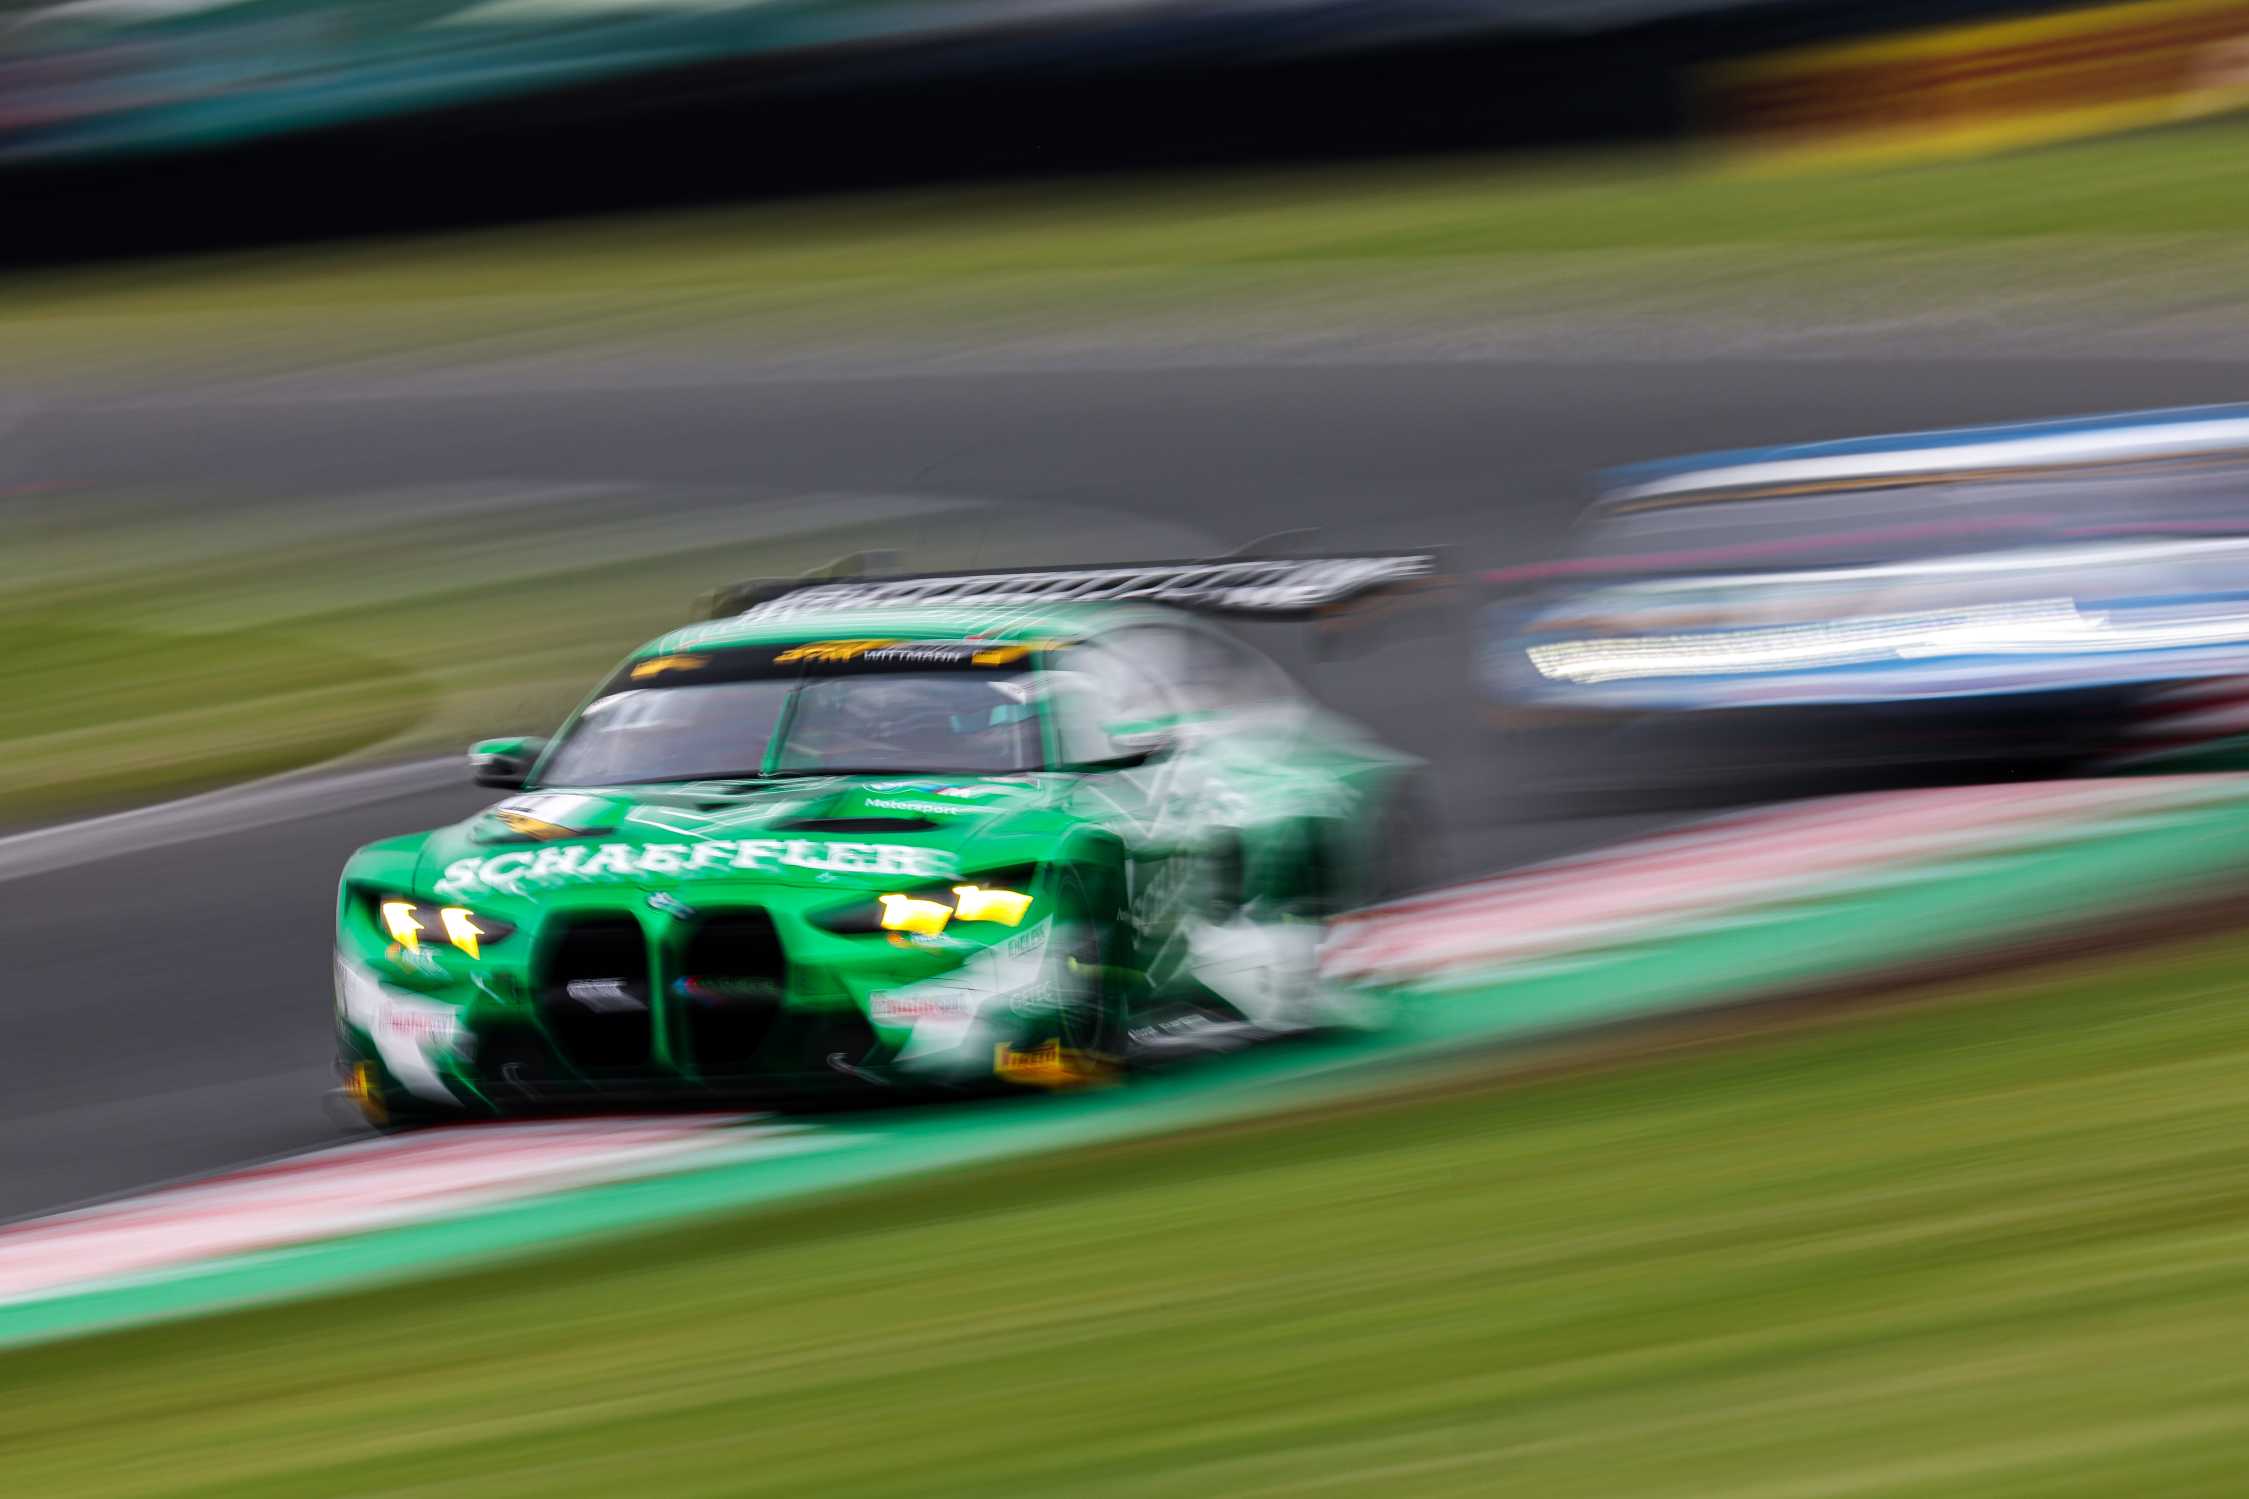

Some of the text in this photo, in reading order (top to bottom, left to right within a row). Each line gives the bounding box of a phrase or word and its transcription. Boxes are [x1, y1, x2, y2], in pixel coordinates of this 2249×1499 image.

[863, 648, 961, 663] WITTMANN
[864, 798, 961, 815] Motorsport
[433, 838, 962, 894] SCHAEFFLER
